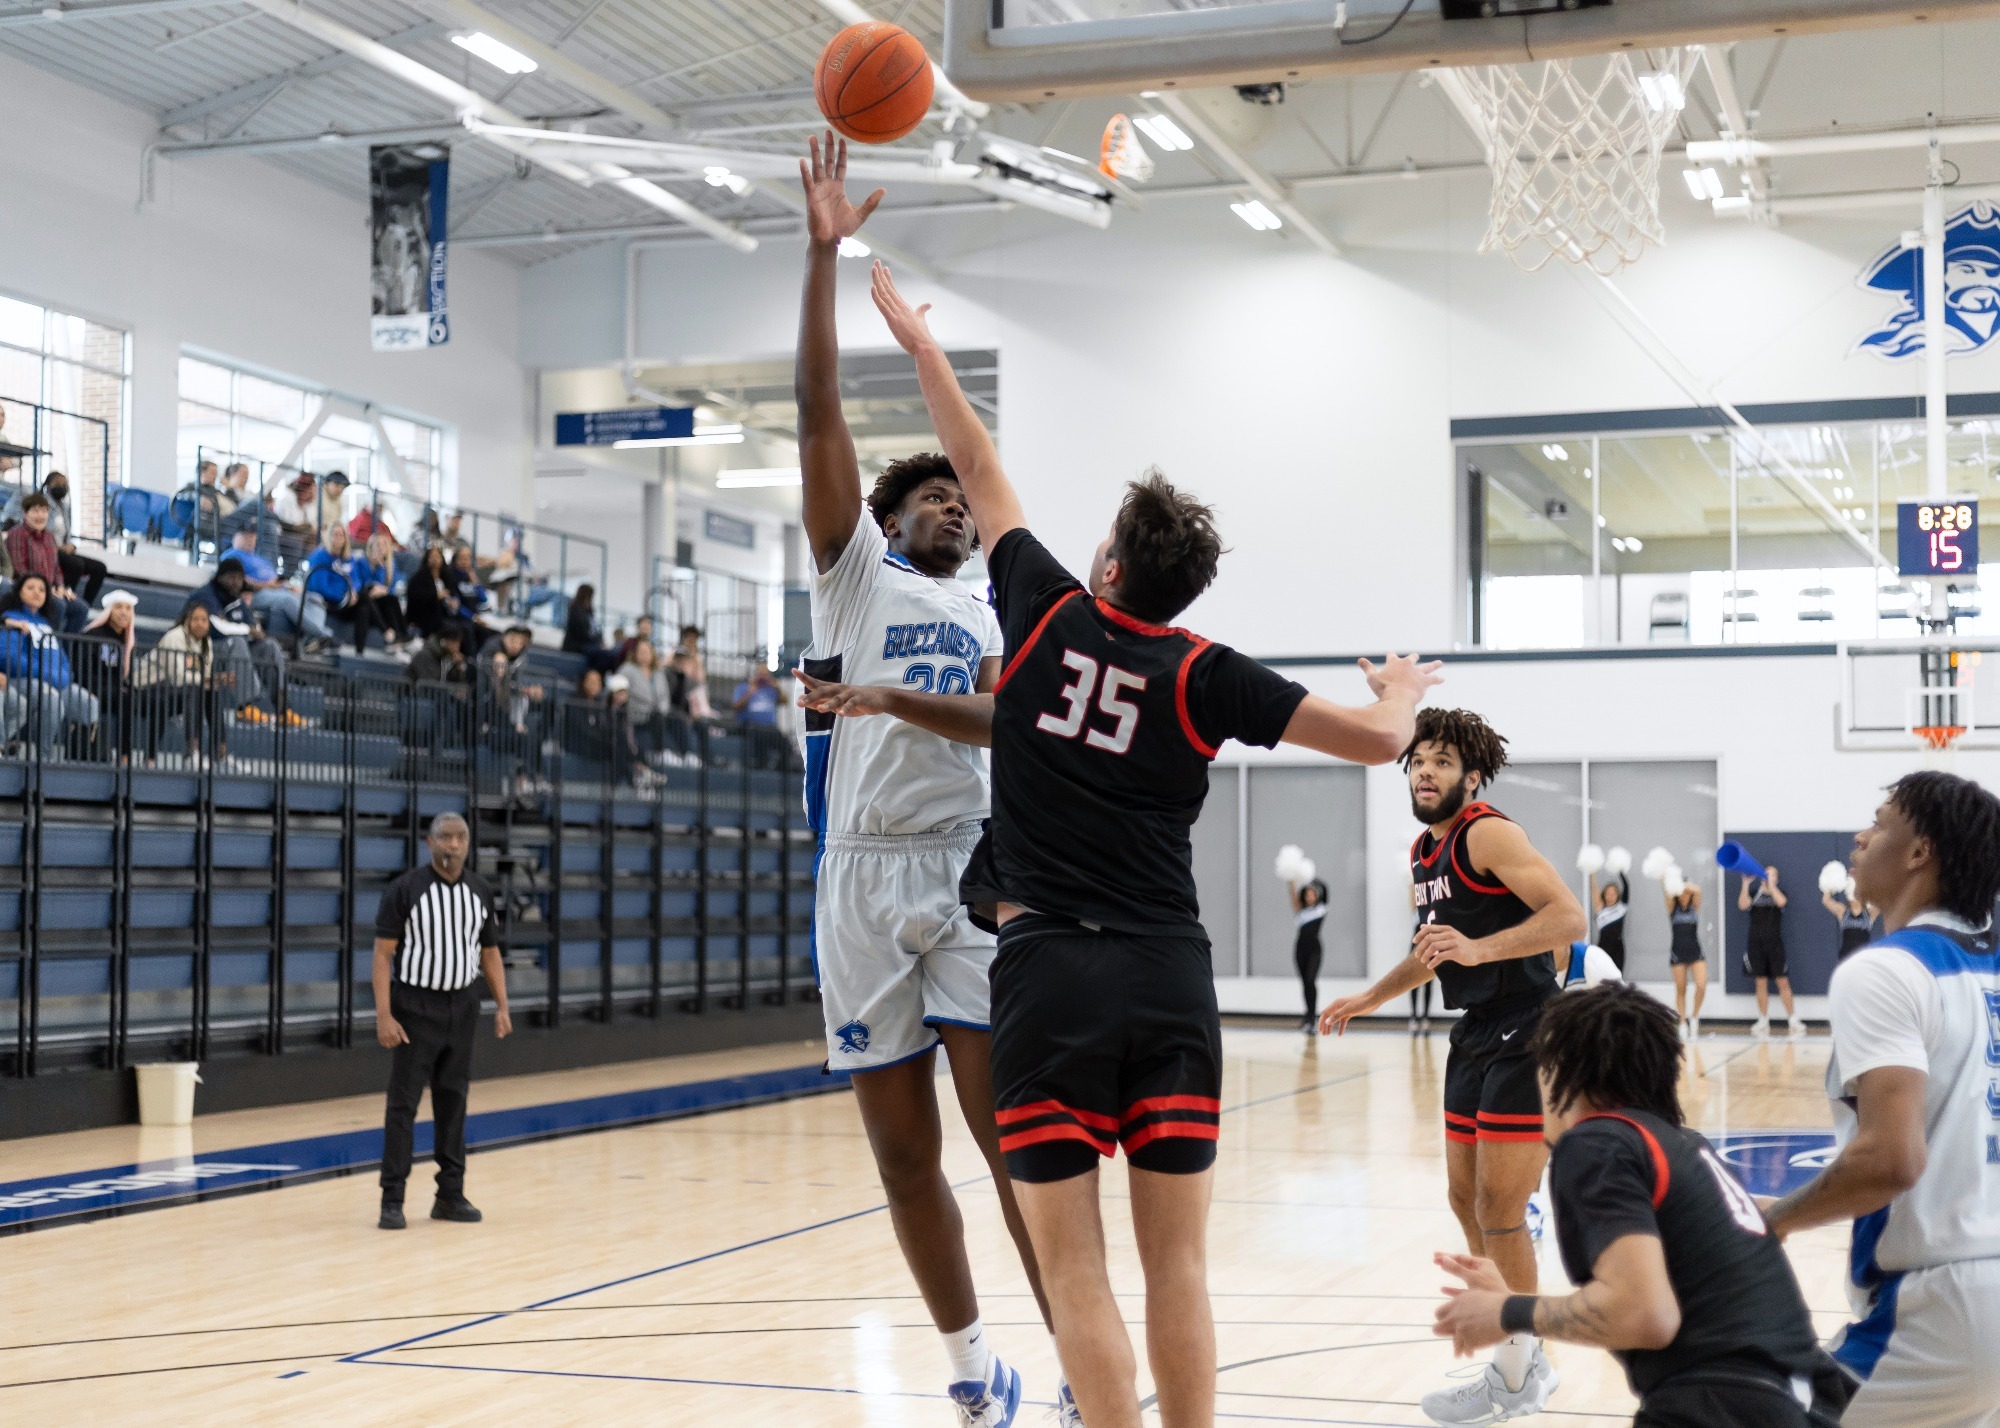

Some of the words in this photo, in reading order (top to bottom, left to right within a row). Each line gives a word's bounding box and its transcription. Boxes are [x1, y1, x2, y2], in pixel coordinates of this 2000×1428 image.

[1918, 505, 1972, 531] 8:28
[1930, 529, 1963, 570] 15
[1036, 647, 1147, 754] 35
